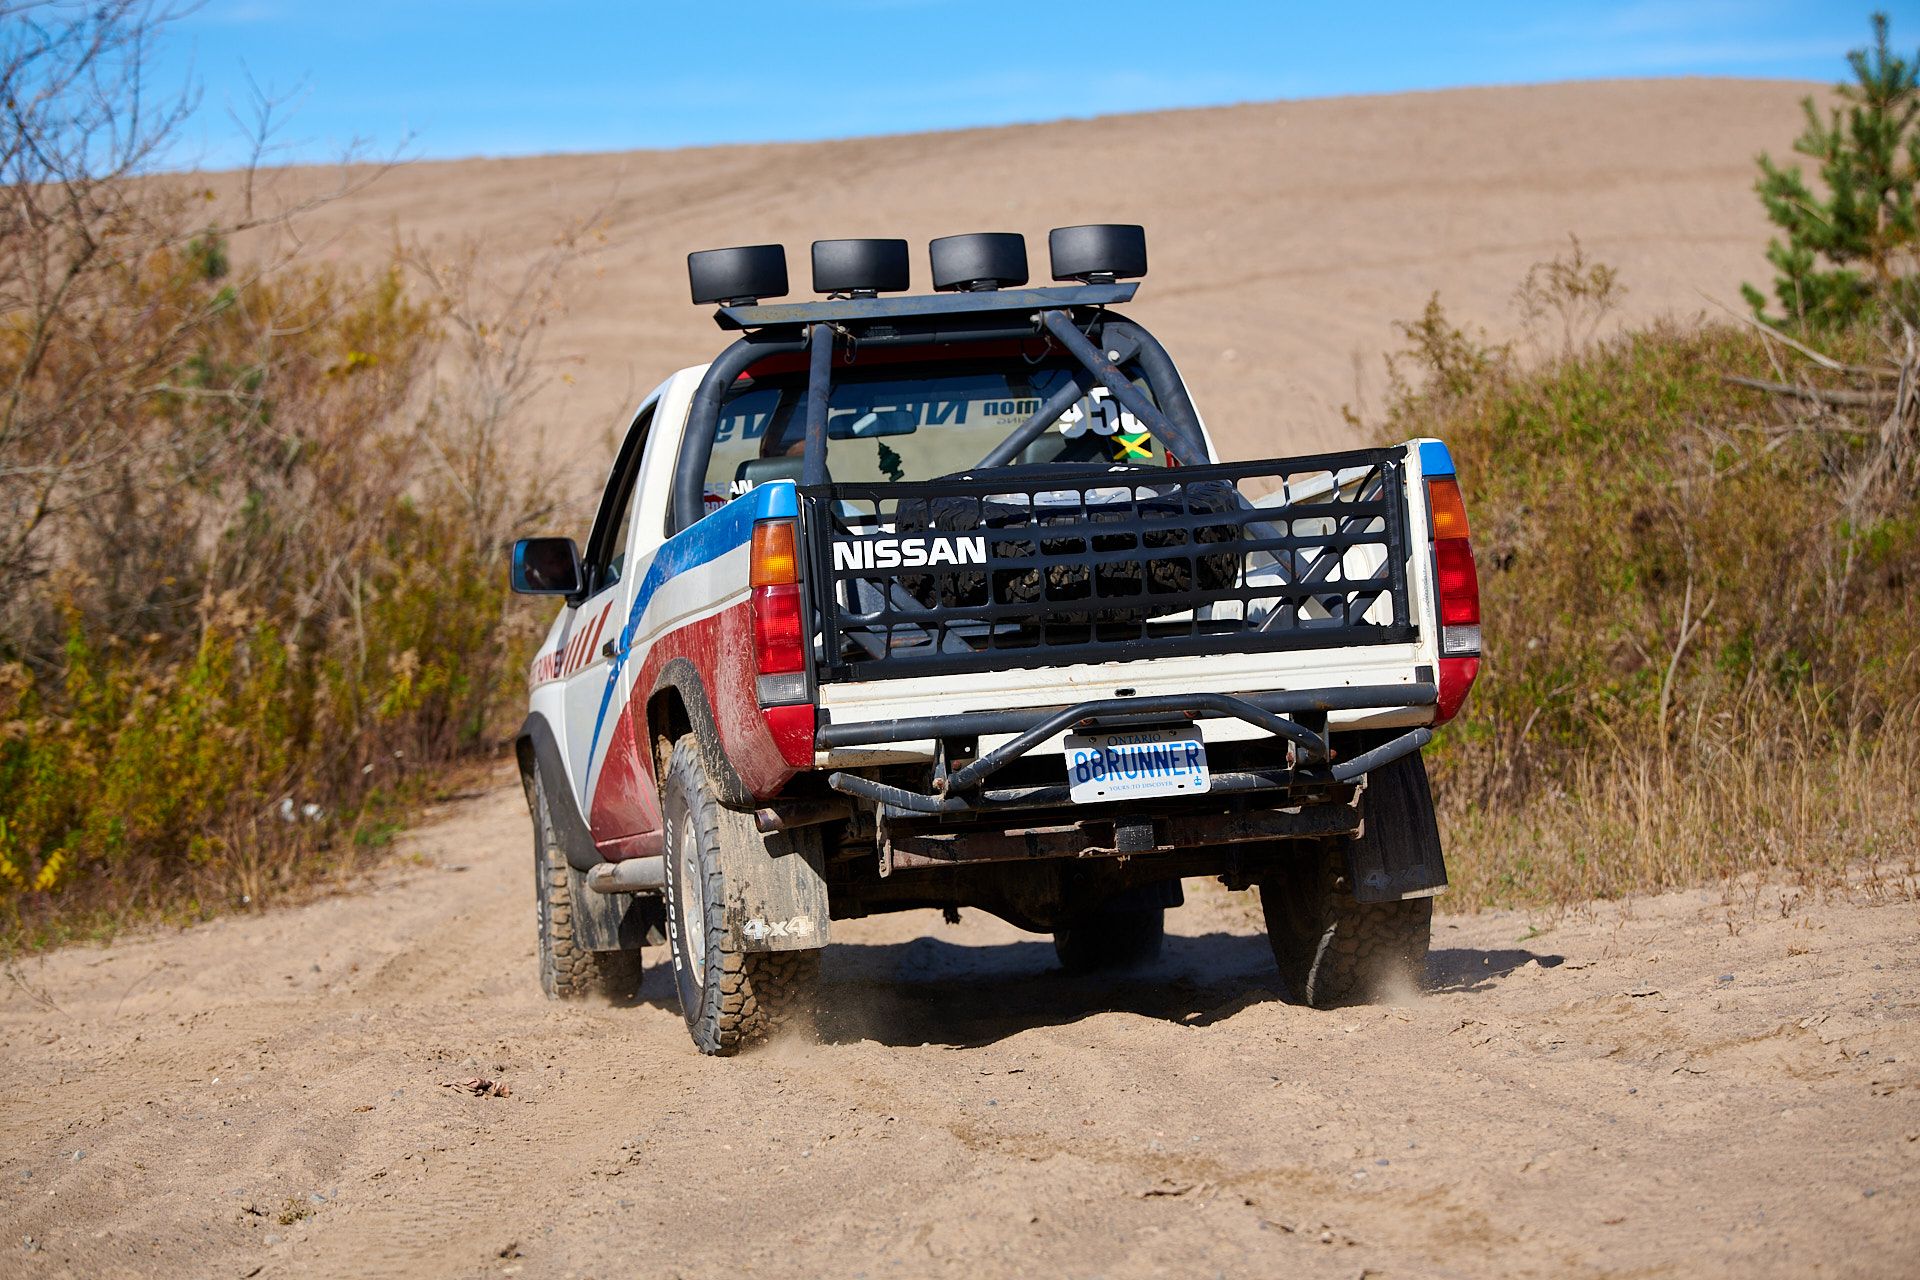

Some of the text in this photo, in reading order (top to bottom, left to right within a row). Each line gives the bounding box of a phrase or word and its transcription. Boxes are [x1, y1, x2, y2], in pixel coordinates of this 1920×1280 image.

[833, 536, 987, 571] NISSAN
[1107, 733, 1161, 747] ONTARIO
[1074, 742, 1202, 783] 88RUNNER
[742, 915, 815, 940] 4x4
